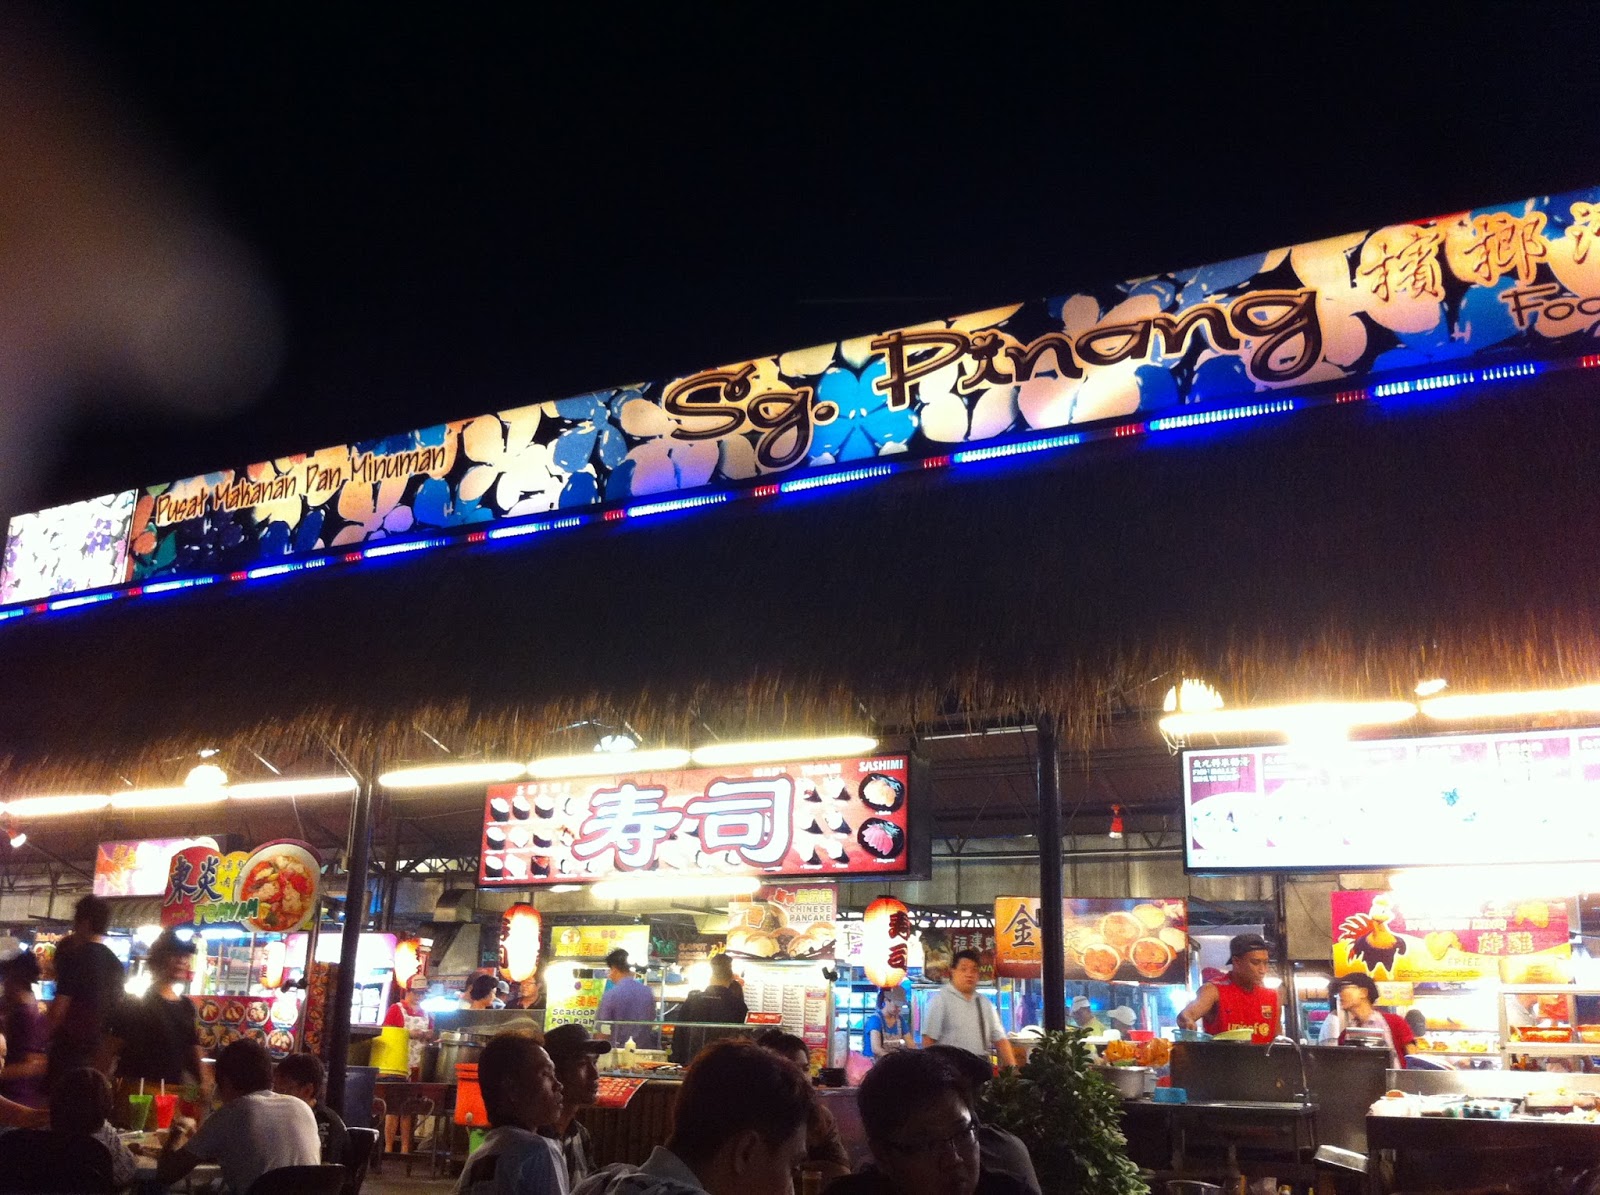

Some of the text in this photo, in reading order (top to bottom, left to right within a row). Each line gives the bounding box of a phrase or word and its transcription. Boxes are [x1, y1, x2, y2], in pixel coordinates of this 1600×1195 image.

[665, 290, 1320, 468] Sg. Pinang
[156, 486, 208, 525] Pusat
[215, 475, 297, 511] Makanan
[350, 445, 446, 483] Minuman
[858, 759, 904, 772] SASHIMI
[572, 773, 794, 872] 寿司
[789, 905, 831, 913] CHINESE
[789, 914, 831, 922] PANCAKE
